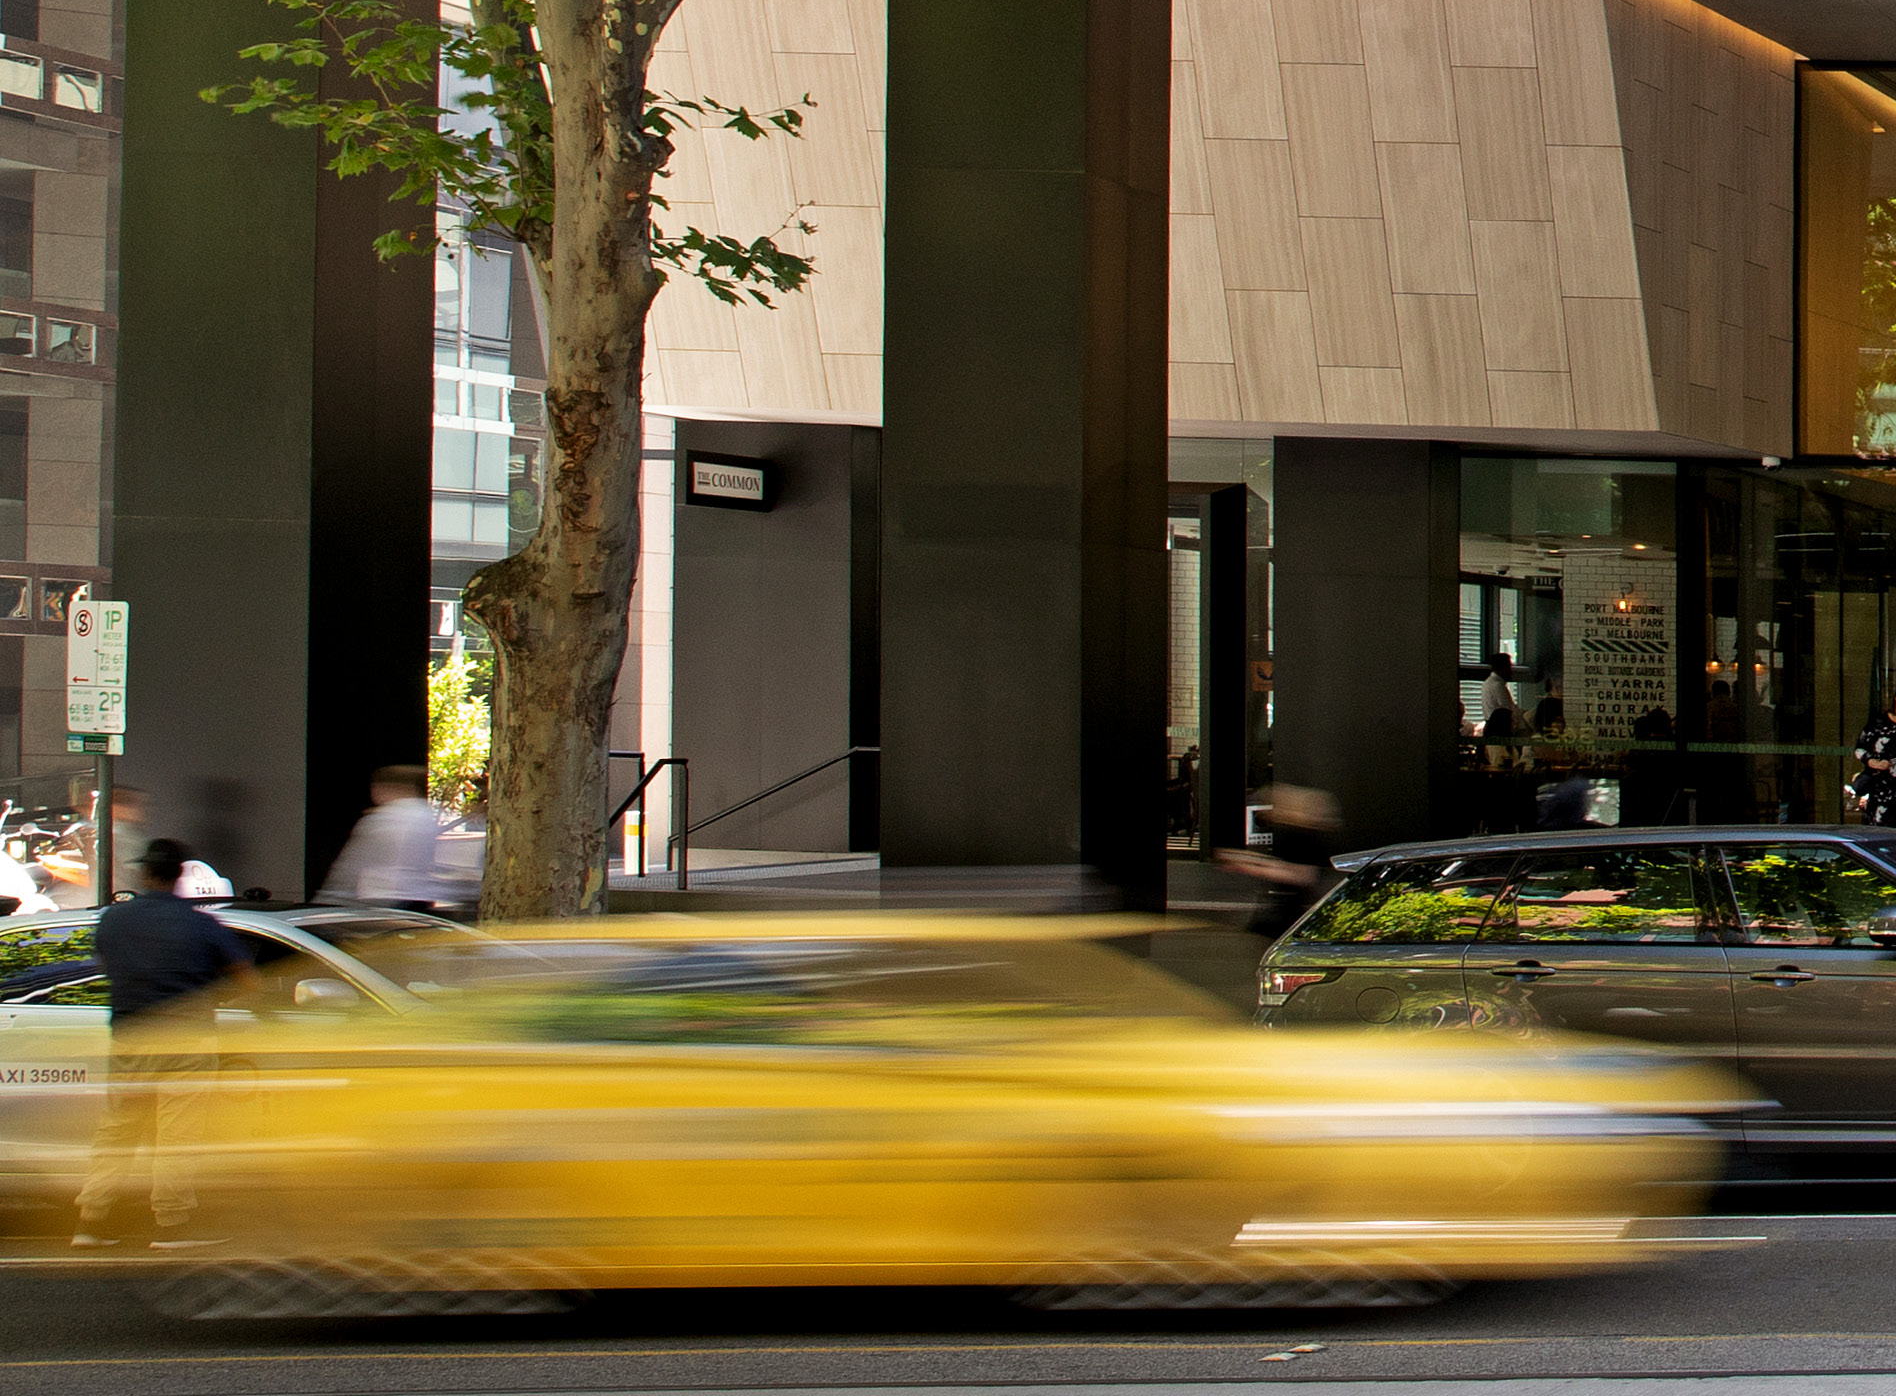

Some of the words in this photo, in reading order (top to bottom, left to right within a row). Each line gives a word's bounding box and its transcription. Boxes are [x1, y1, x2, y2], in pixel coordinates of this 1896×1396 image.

[697, 471, 711, 481] THE
[712, 472, 760, 491] COMMON
[1585, 604, 1606, 613] PORT
[105, 610, 122, 630] 1P
[1597, 617, 1631, 627] MIDDLE
[1640, 618, 1664, 627] PARK
[1607, 629, 1664, 640] MELBOURNE
[1585, 653, 1664, 664] SOUTHBANK
[1610, 678, 1665, 689] YARRA
[99, 691, 122, 711] 2P
[1597, 691, 1665, 702] CREMORNE
[1585, 716, 1637, 726] ARMAD
[1598, 728, 1637, 738] MALV
[195, 886, 217, 896] TAXI
[30, 1068, 86, 1083] 3596M
